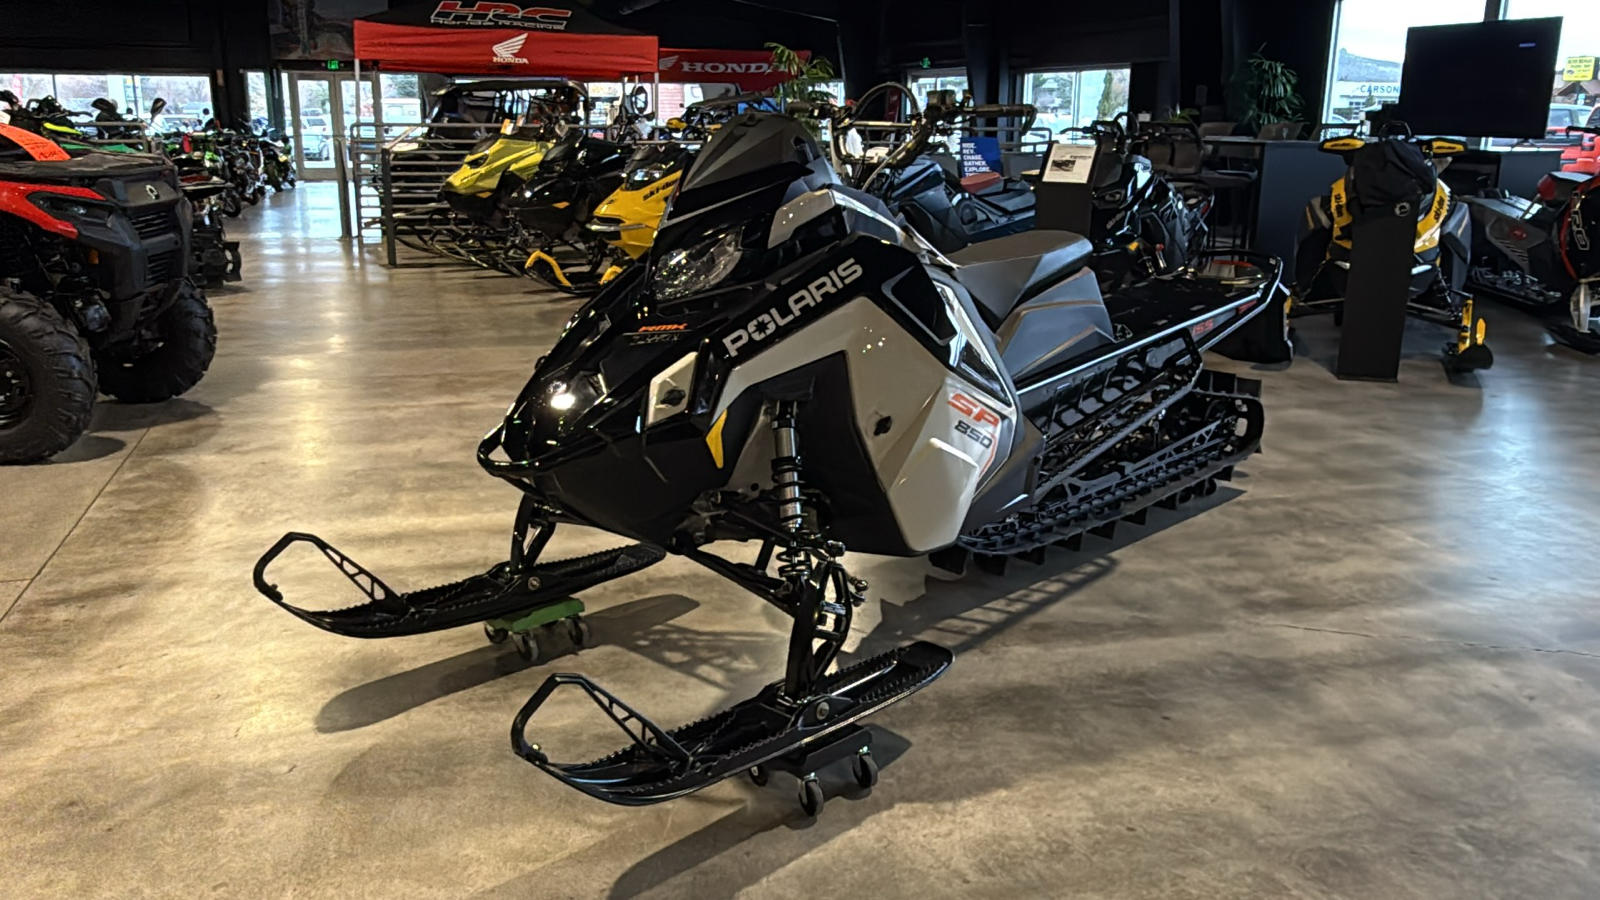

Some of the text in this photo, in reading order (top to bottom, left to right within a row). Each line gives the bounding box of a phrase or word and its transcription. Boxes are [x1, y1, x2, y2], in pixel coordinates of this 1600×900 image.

[430, 1, 572, 26] HRC
[1360, 84, 1400, 94] CARSON
[722, 257, 863, 358] POLARIS
[946, 392, 1000, 428] SP
[954, 419, 993, 450] 850
